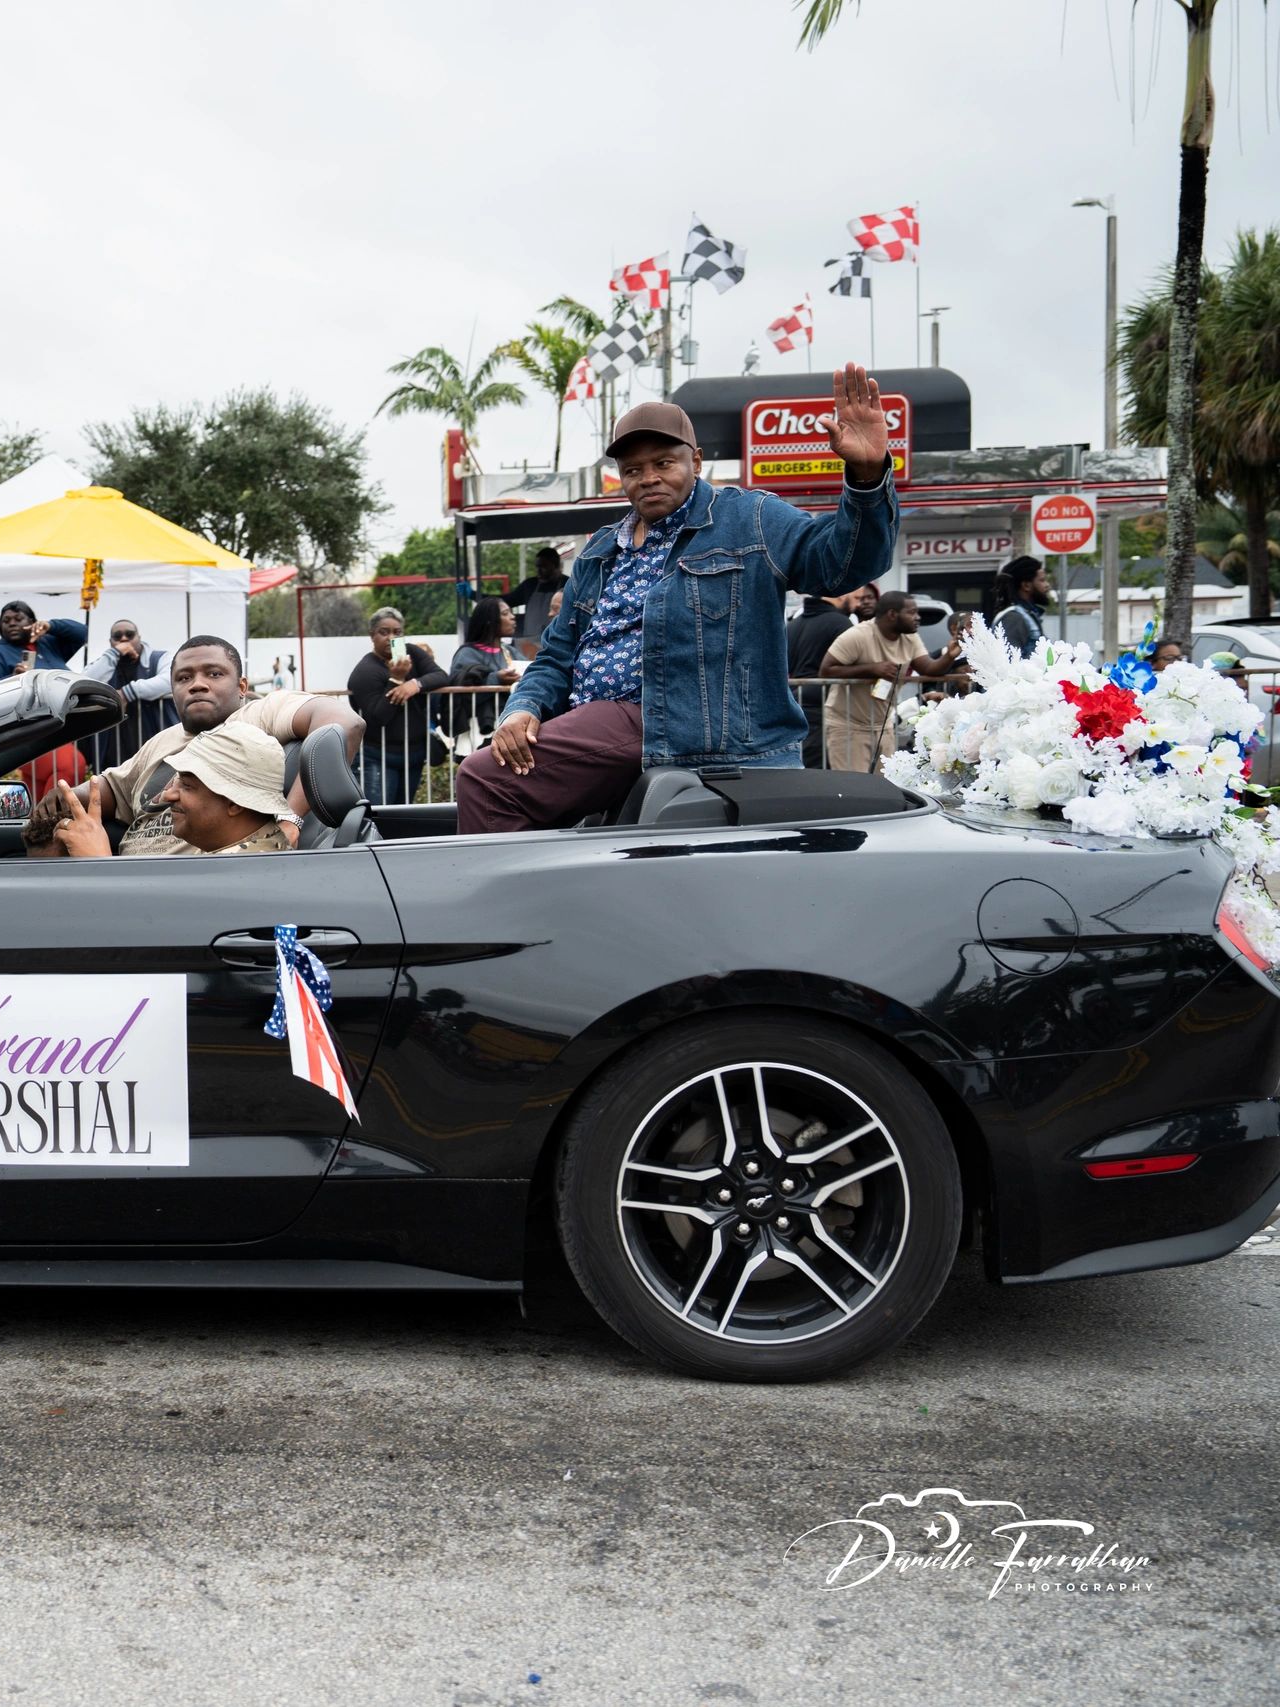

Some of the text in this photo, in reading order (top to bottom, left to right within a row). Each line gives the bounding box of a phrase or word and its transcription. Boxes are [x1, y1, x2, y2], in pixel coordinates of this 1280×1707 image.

[754, 407, 902, 436] Checs
[760, 460, 844, 474] BURGERS FRIE
[1041, 505, 1086, 518] DO NOT
[1045, 531, 1083, 543] ENTER
[906, 537, 1013, 556] PICK UP
